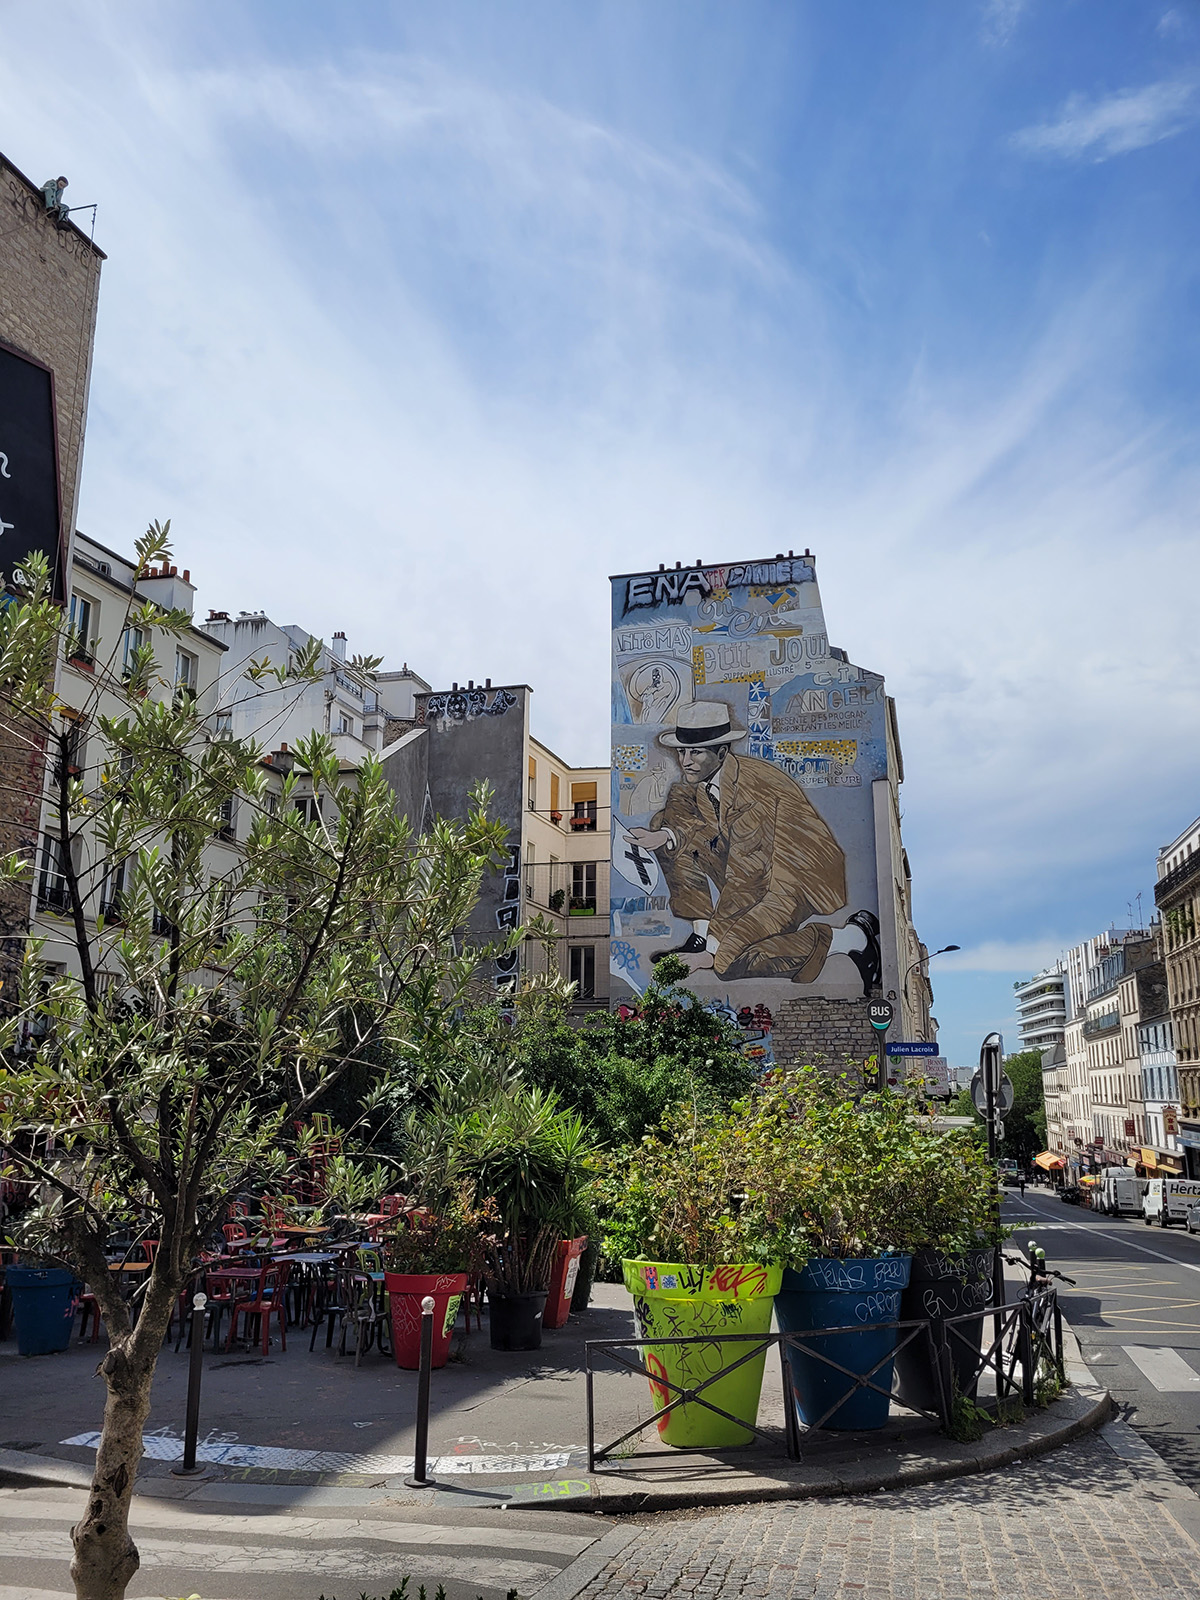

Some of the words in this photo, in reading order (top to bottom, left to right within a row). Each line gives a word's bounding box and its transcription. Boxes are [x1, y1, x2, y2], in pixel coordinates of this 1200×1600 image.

[621, 570, 713, 619] ENA
[805, 661, 811, 669] 5
[824, 720, 837, 730] LES
[870, 1006, 890, 1016] BUS
[867, 1076, 876, 1084] 71
